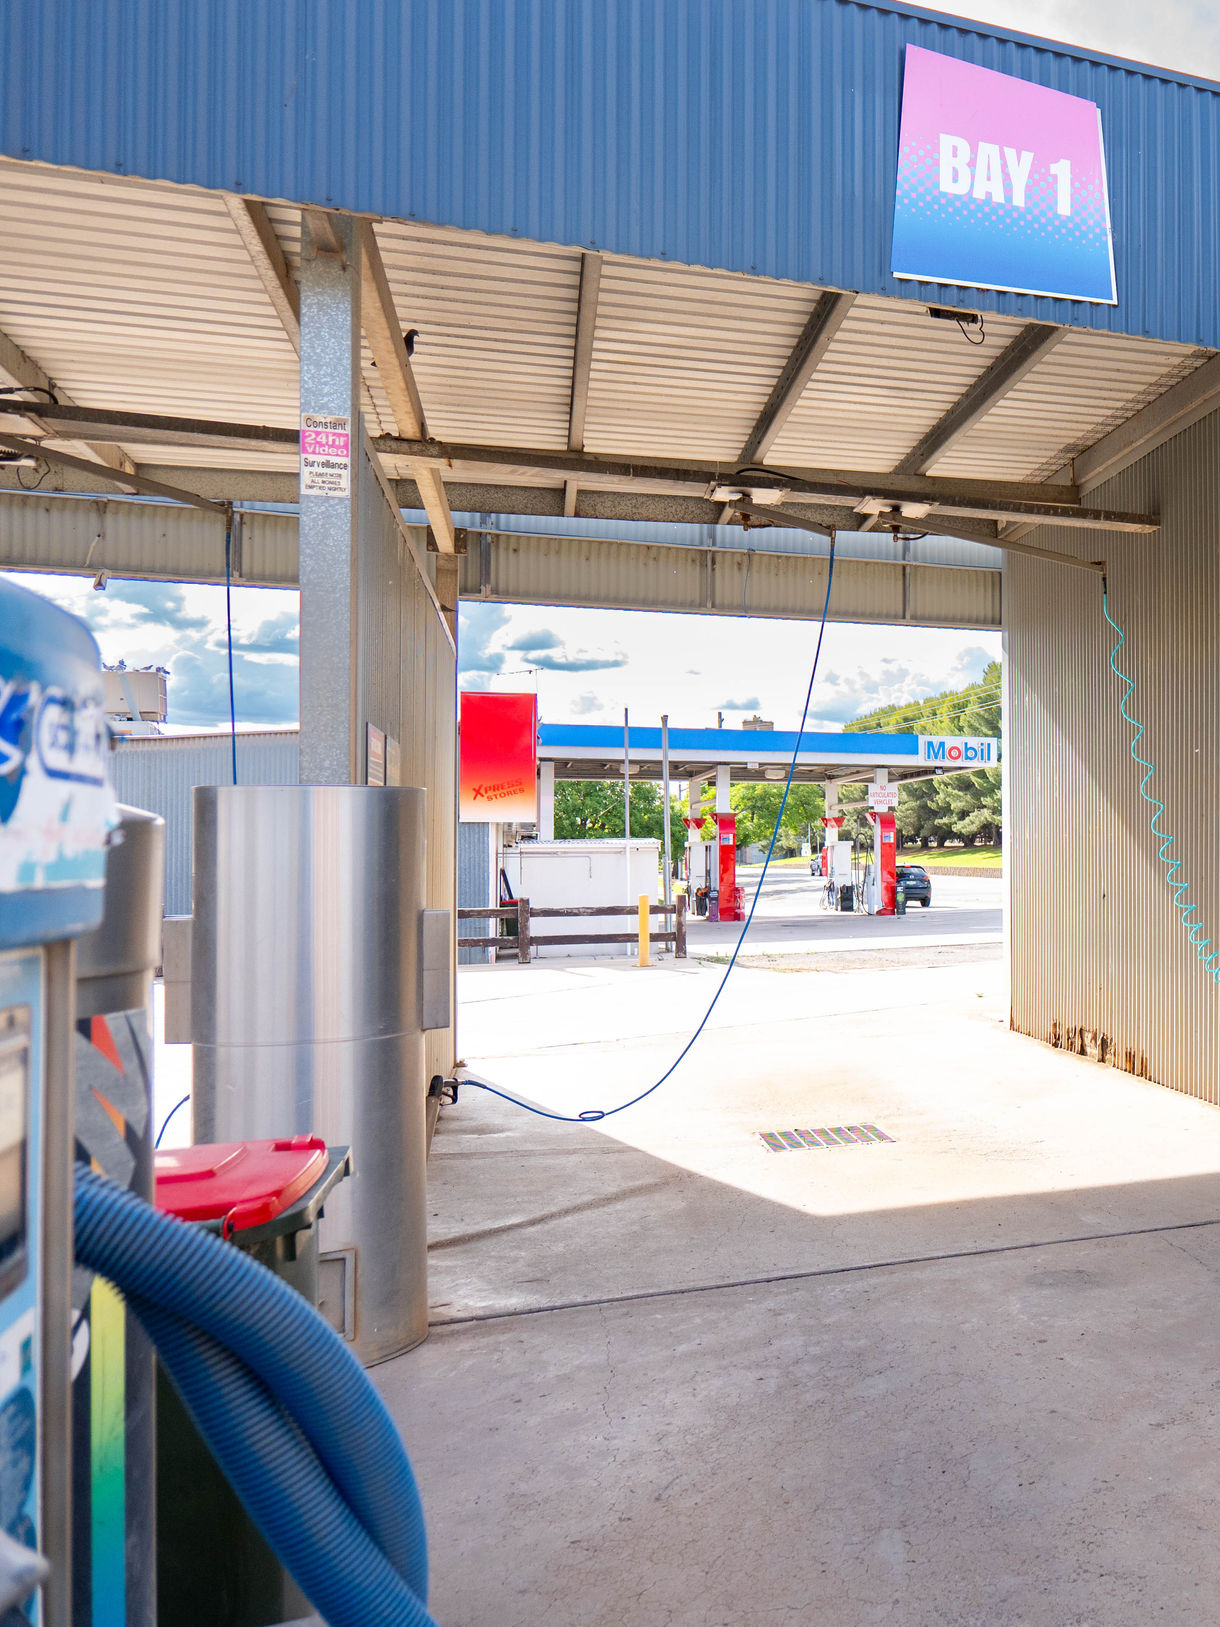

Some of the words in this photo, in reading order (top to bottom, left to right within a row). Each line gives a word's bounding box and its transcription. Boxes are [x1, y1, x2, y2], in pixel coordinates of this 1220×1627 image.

[939, 133, 1034, 207] BAY
[1050, 158, 1071, 216] 1
[305, 417, 347, 431] Constant
[304, 431, 347, 446] 24hr
[304, 443, 347, 456] Video
[303, 457, 348, 471] Surveillance
[926, 740, 991, 761] Mobil
[472, 779, 523, 801] XPRESS
[486, 787, 525, 802] STORES
[870, 791, 897, 799] ARTICULATED
